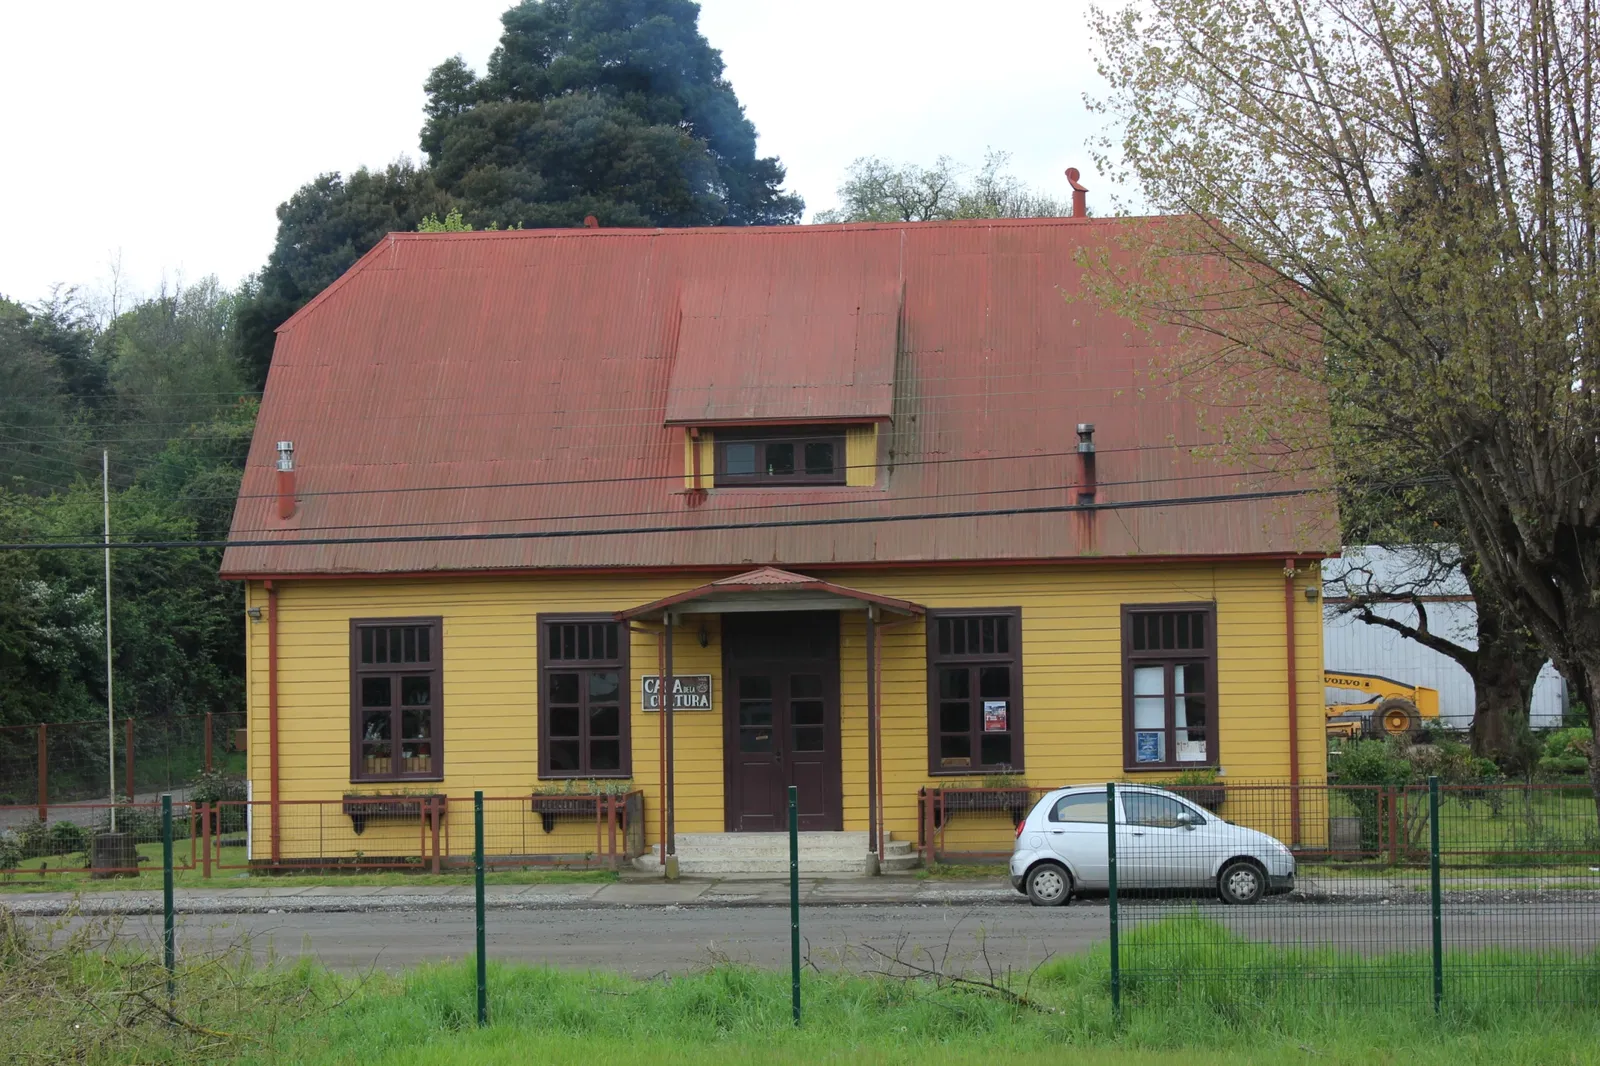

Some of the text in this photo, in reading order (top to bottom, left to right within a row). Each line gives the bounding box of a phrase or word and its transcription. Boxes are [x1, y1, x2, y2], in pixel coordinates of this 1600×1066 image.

[644, 679, 683, 693] CAA
[1324, 677, 1360, 686] VOLVO
[650, 694, 708, 707] CUTURA
